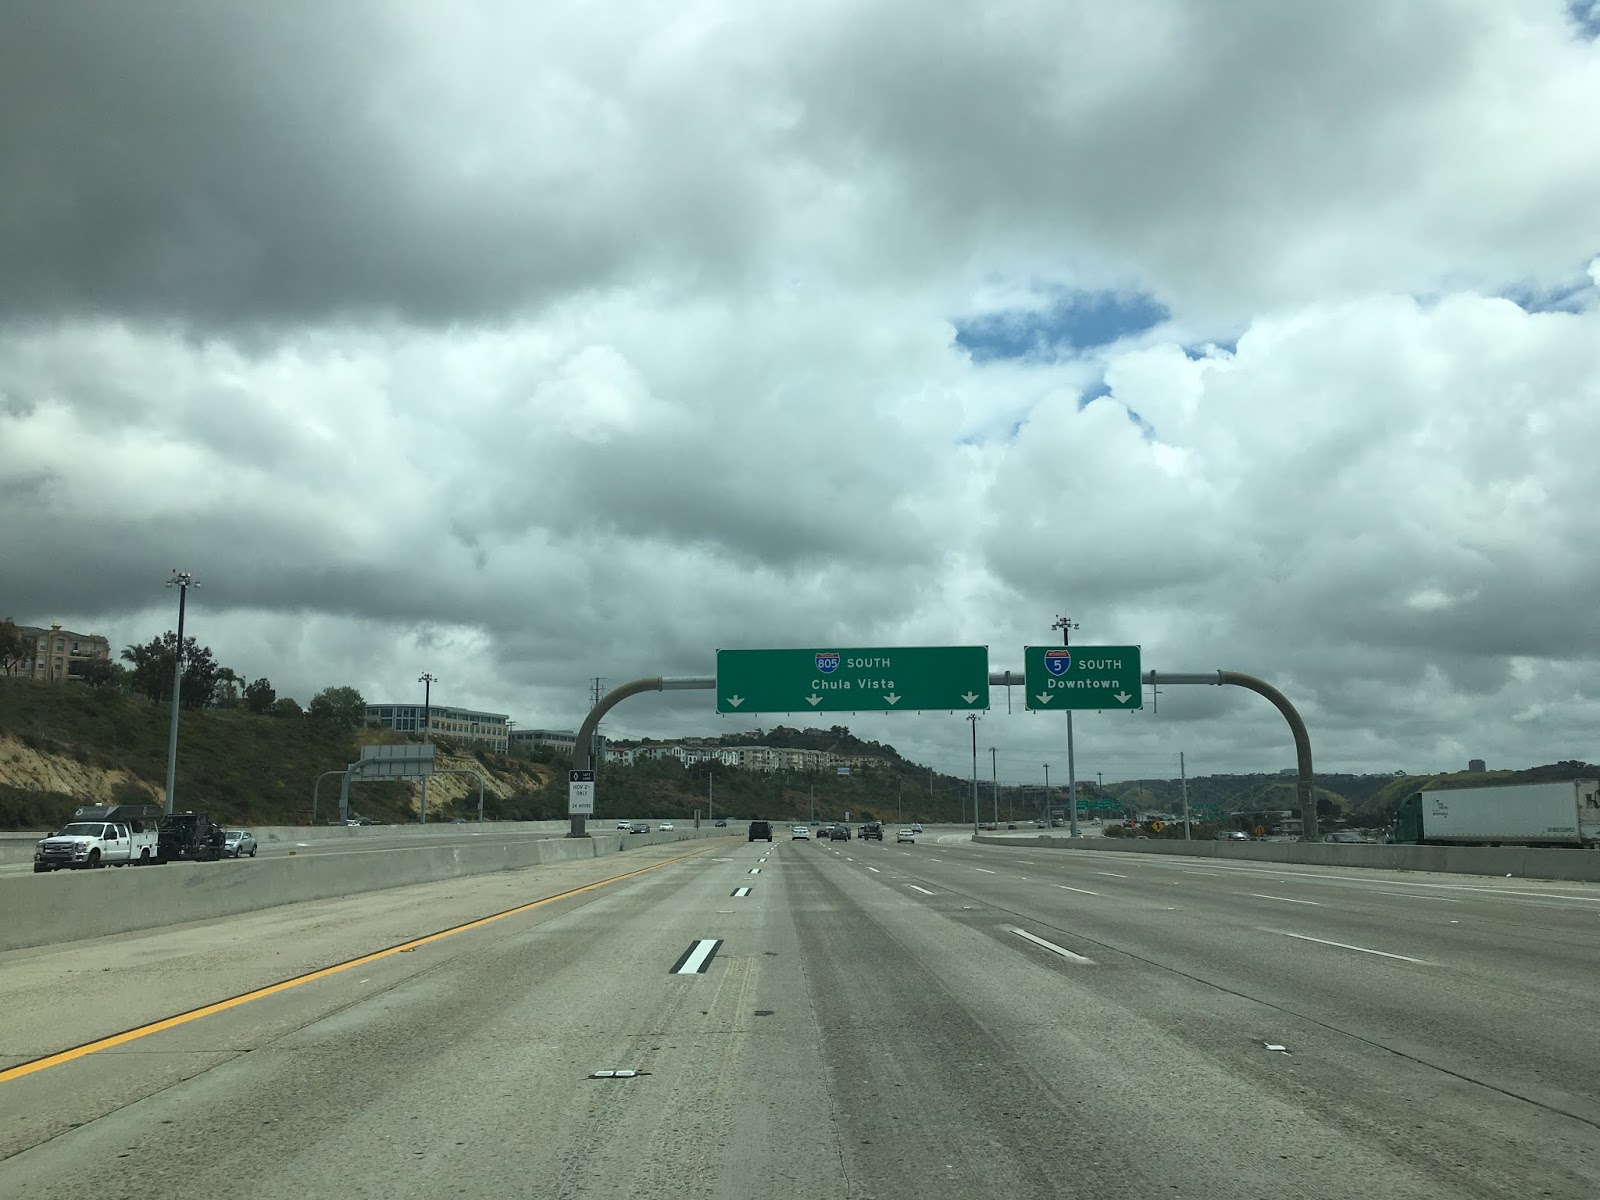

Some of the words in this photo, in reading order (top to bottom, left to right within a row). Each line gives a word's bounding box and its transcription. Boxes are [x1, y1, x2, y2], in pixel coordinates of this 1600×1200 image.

[818, 658, 838, 669] 805
[847, 658, 890, 668] SOUTH
[1053, 660, 1062, 671] 5
[1078, 659, 1122, 670] SOUTH
[811, 679, 851, 690] Chula
[857, 678, 895, 689] Vista
[1047, 678, 1119, 689] Downtown
